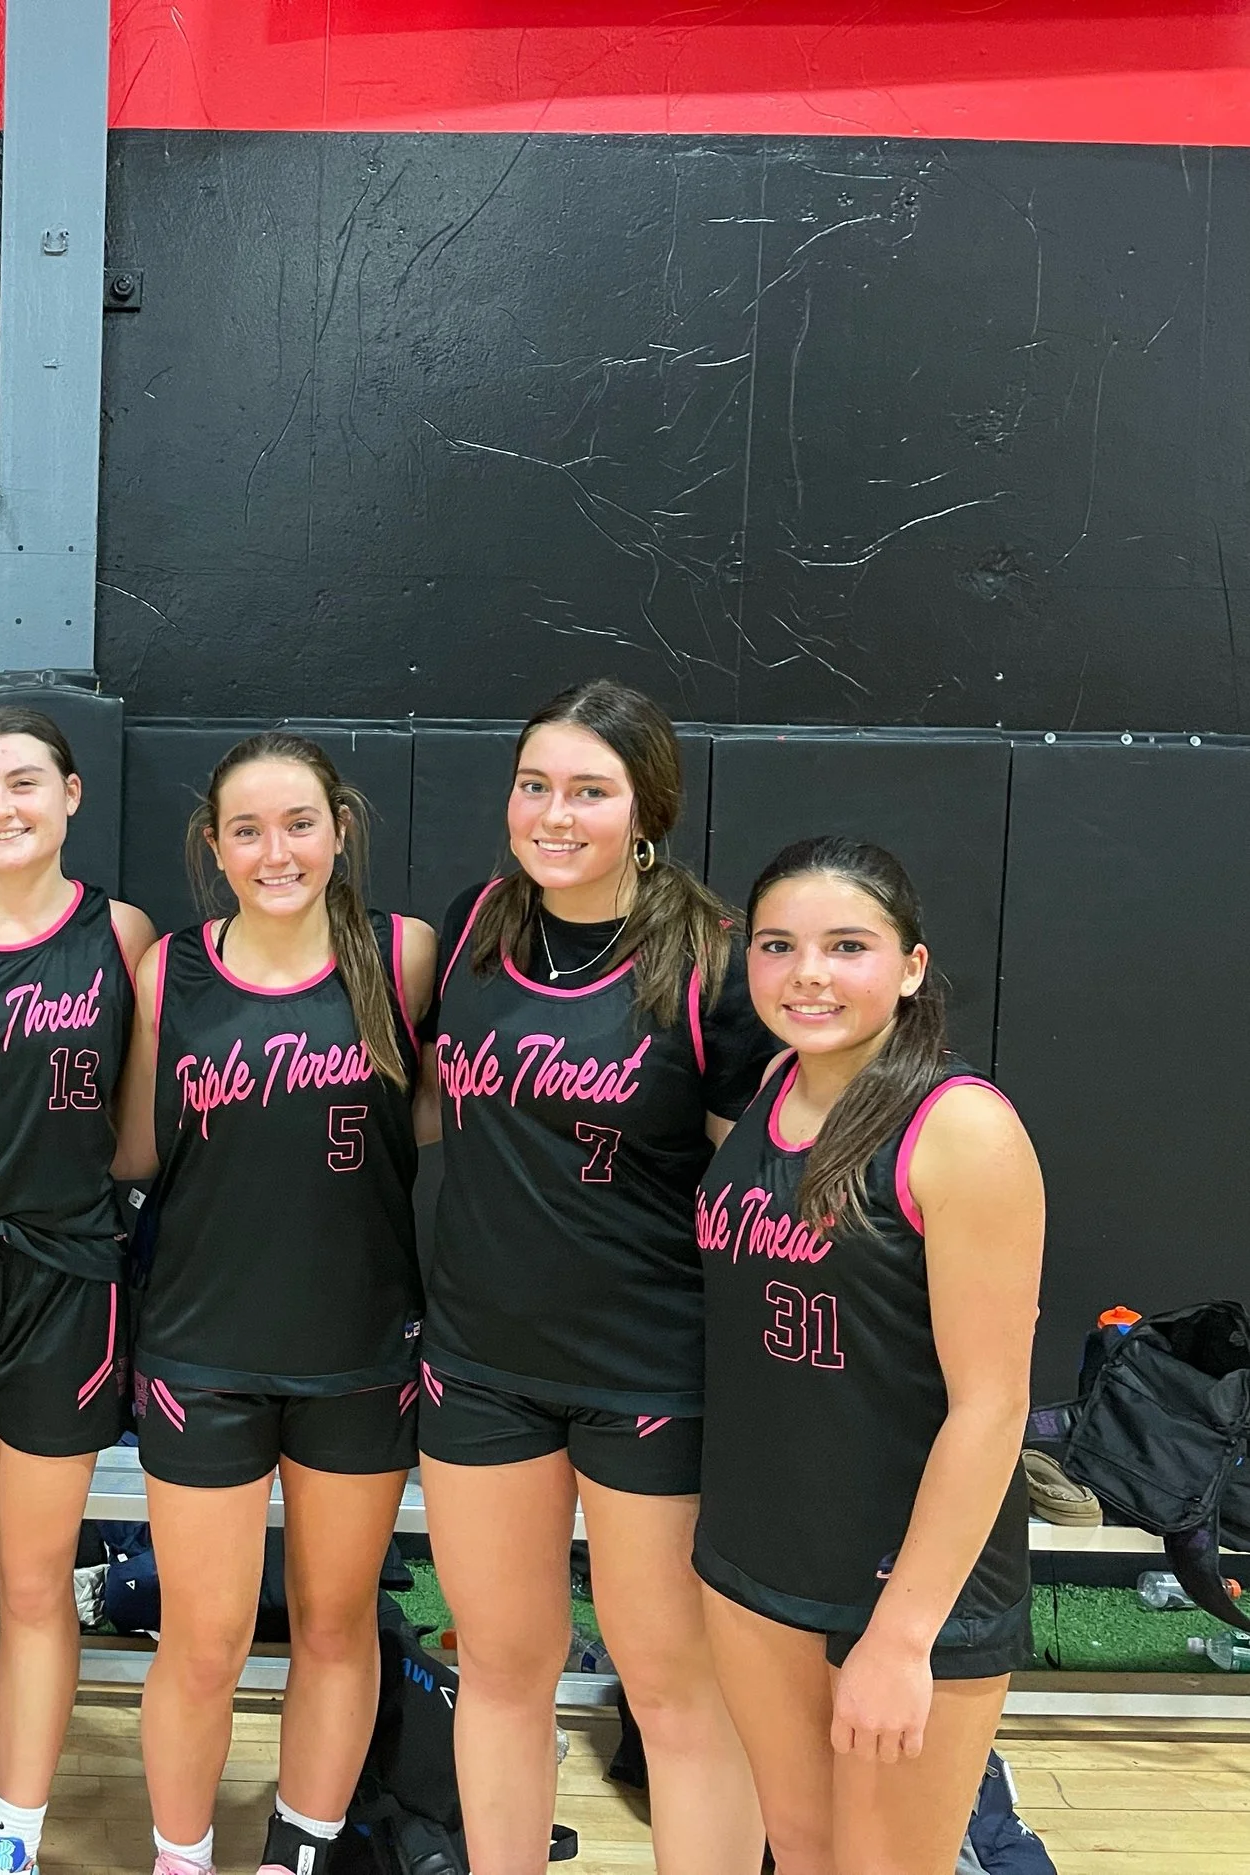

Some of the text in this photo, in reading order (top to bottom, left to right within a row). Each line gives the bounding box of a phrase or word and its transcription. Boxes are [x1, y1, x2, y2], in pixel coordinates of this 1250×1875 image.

[2, 967, 103, 1052] Threat
[48, 1047, 102, 1111] 13
[176, 1038, 256, 1141] Triple
[436, 1029, 652, 1131] Triple Threat
[327, 1105, 368, 1172] 5
[575, 1121, 622, 1183] 7
[764, 1280, 845, 1370] 31
